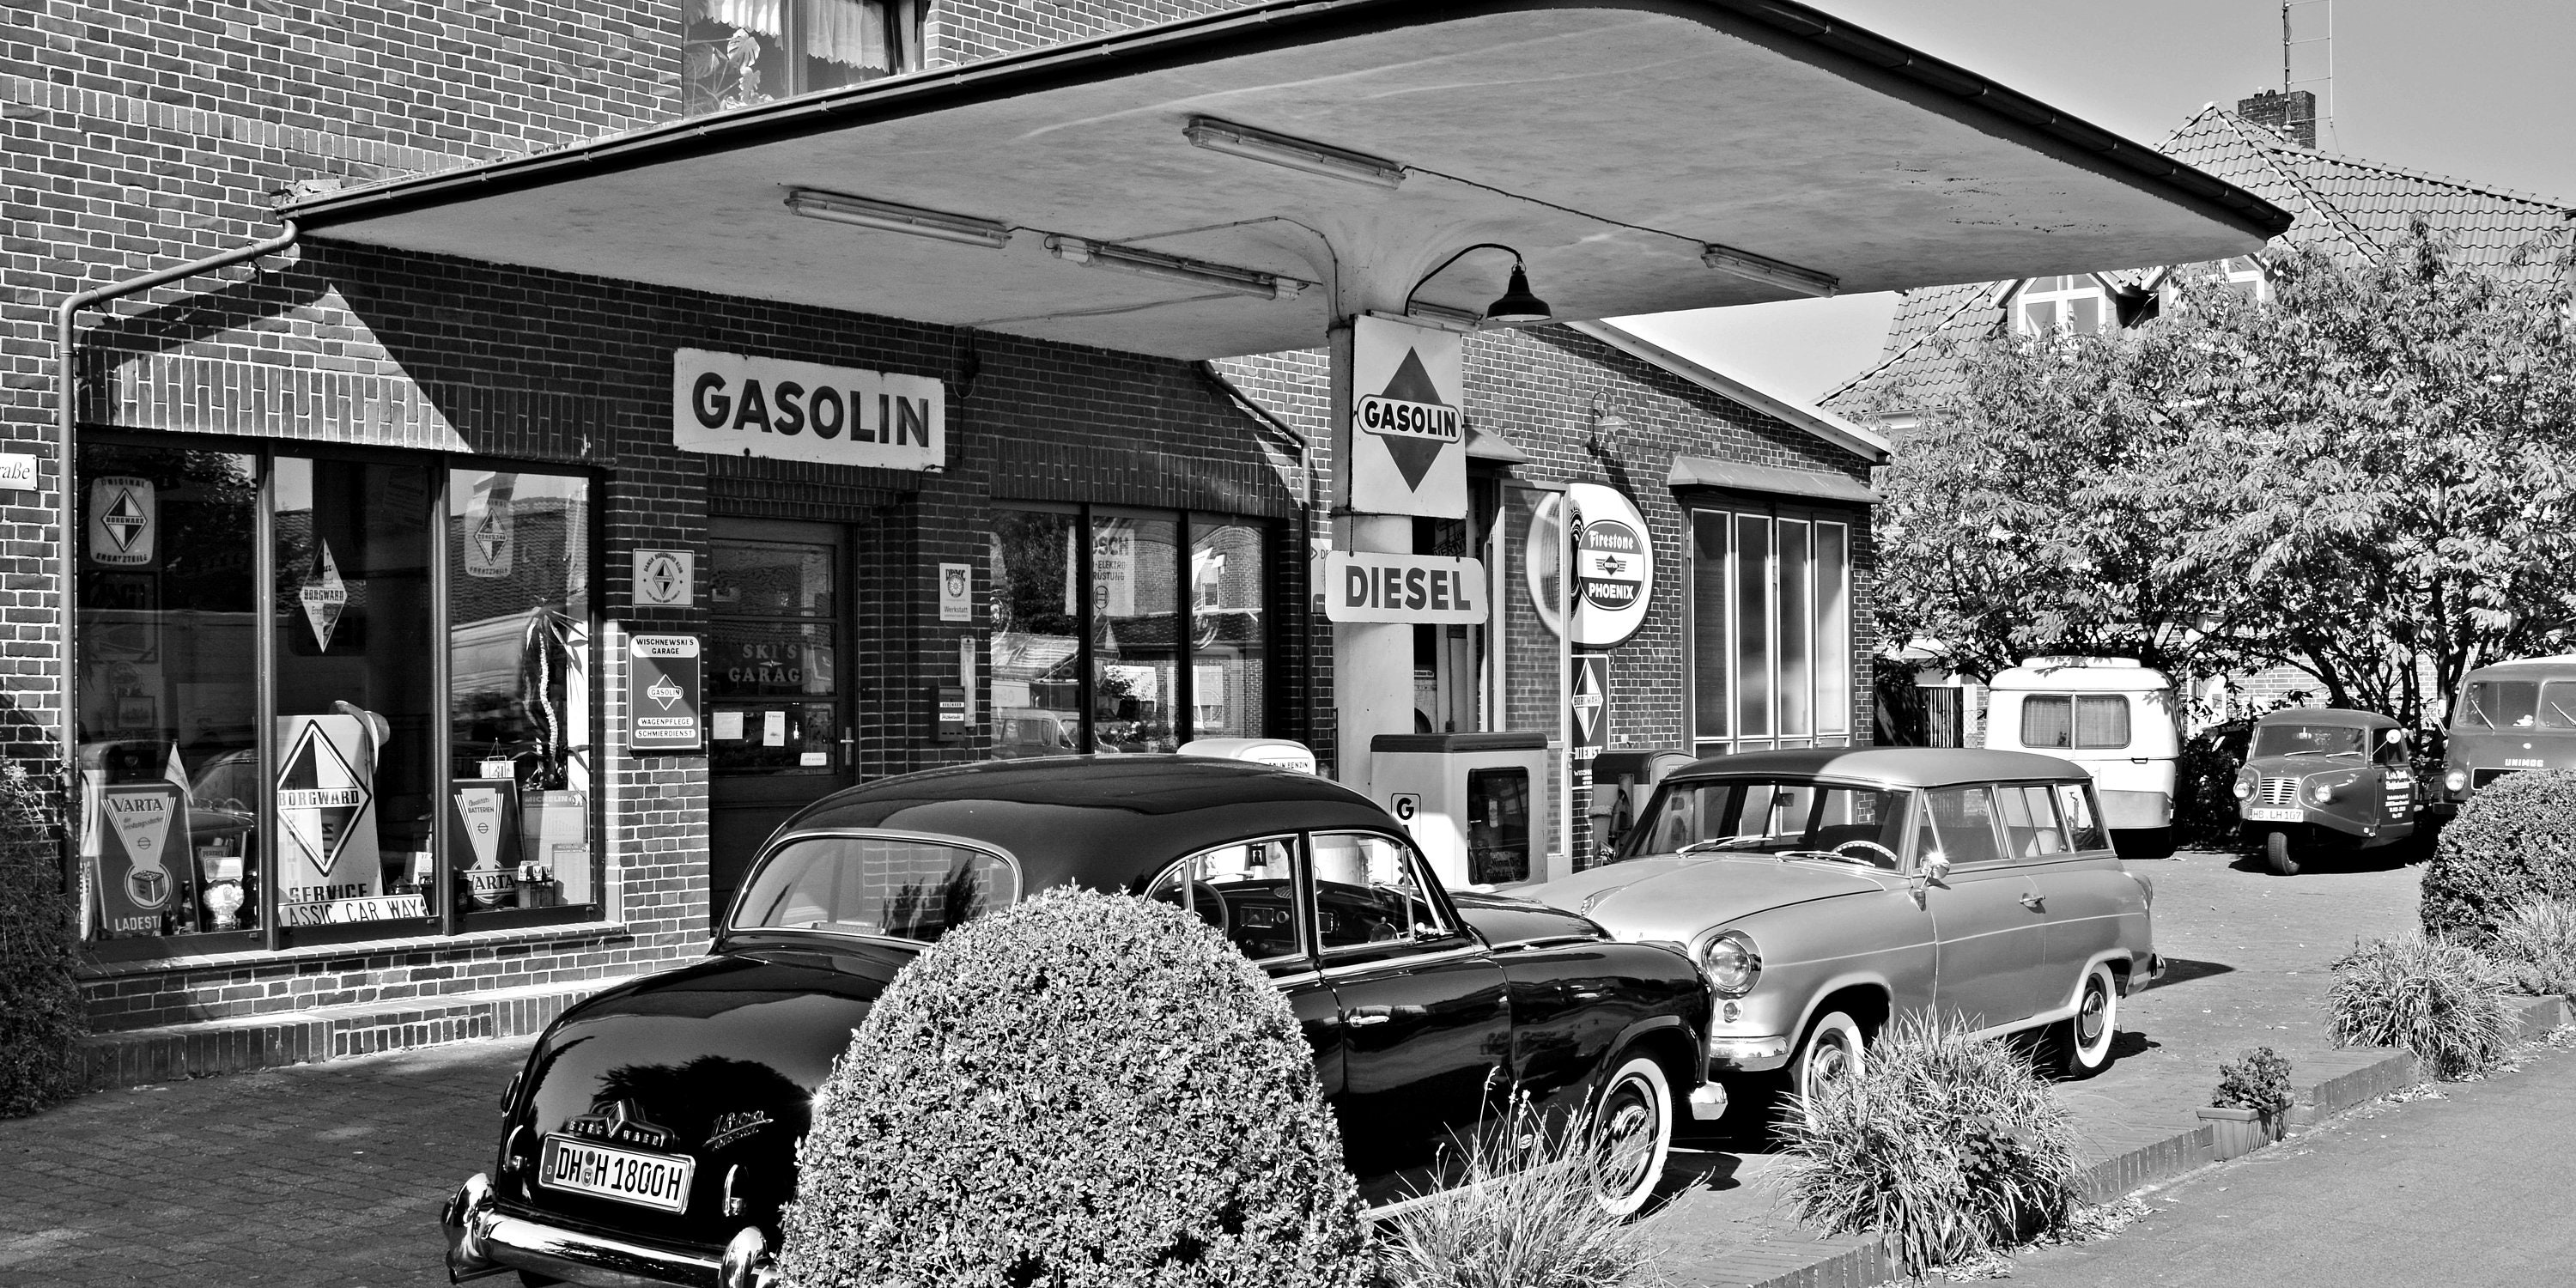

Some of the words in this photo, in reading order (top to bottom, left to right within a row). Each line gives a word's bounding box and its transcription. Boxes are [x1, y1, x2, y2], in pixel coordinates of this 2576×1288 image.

[691, 371, 930, 448] GASOLIN
[1364, 400, 1457, 438] GASOLIN
[101, 478, 145, 488] ORIGINAL
[1093, 536, 1129, 556] OSCH
[1588, 530, 1634, 550] Firestone
[95, 552, 148, 563] ERSATZTEILE
[303, 588, 344, 601] BORGWARD
[1345, 564, 1472, 612] DIESEL
[1588, 582, 1634, 600] PHOENIX
[944, 605, 969, 614] Werkstatt
[728, 666, 800, 683] GARAG
[1573, 696, 1601, 707] BORGWARD
[1573, 745, 1603, 760] DIENST
[1287, 761, 1309, 769] BENZIN
[2504, 758, 2544, 768] UNIMOG
[112, 798, 165, 812] VARTA
[278, 789, 360, 806] BORGWARD
[525, 795, 568, 804] MICHELIN
[2269, 811, 2282, 819] LH
[472, 874, 515, 891] ARTA
[289, 884, 368, 903] SERVICE
[345, 902, 380, 923] CAR
[546, 1164, 553, 1176] D
[555, 1146, 585, 1183] DH
[592, 1152, 610, 1188] H
